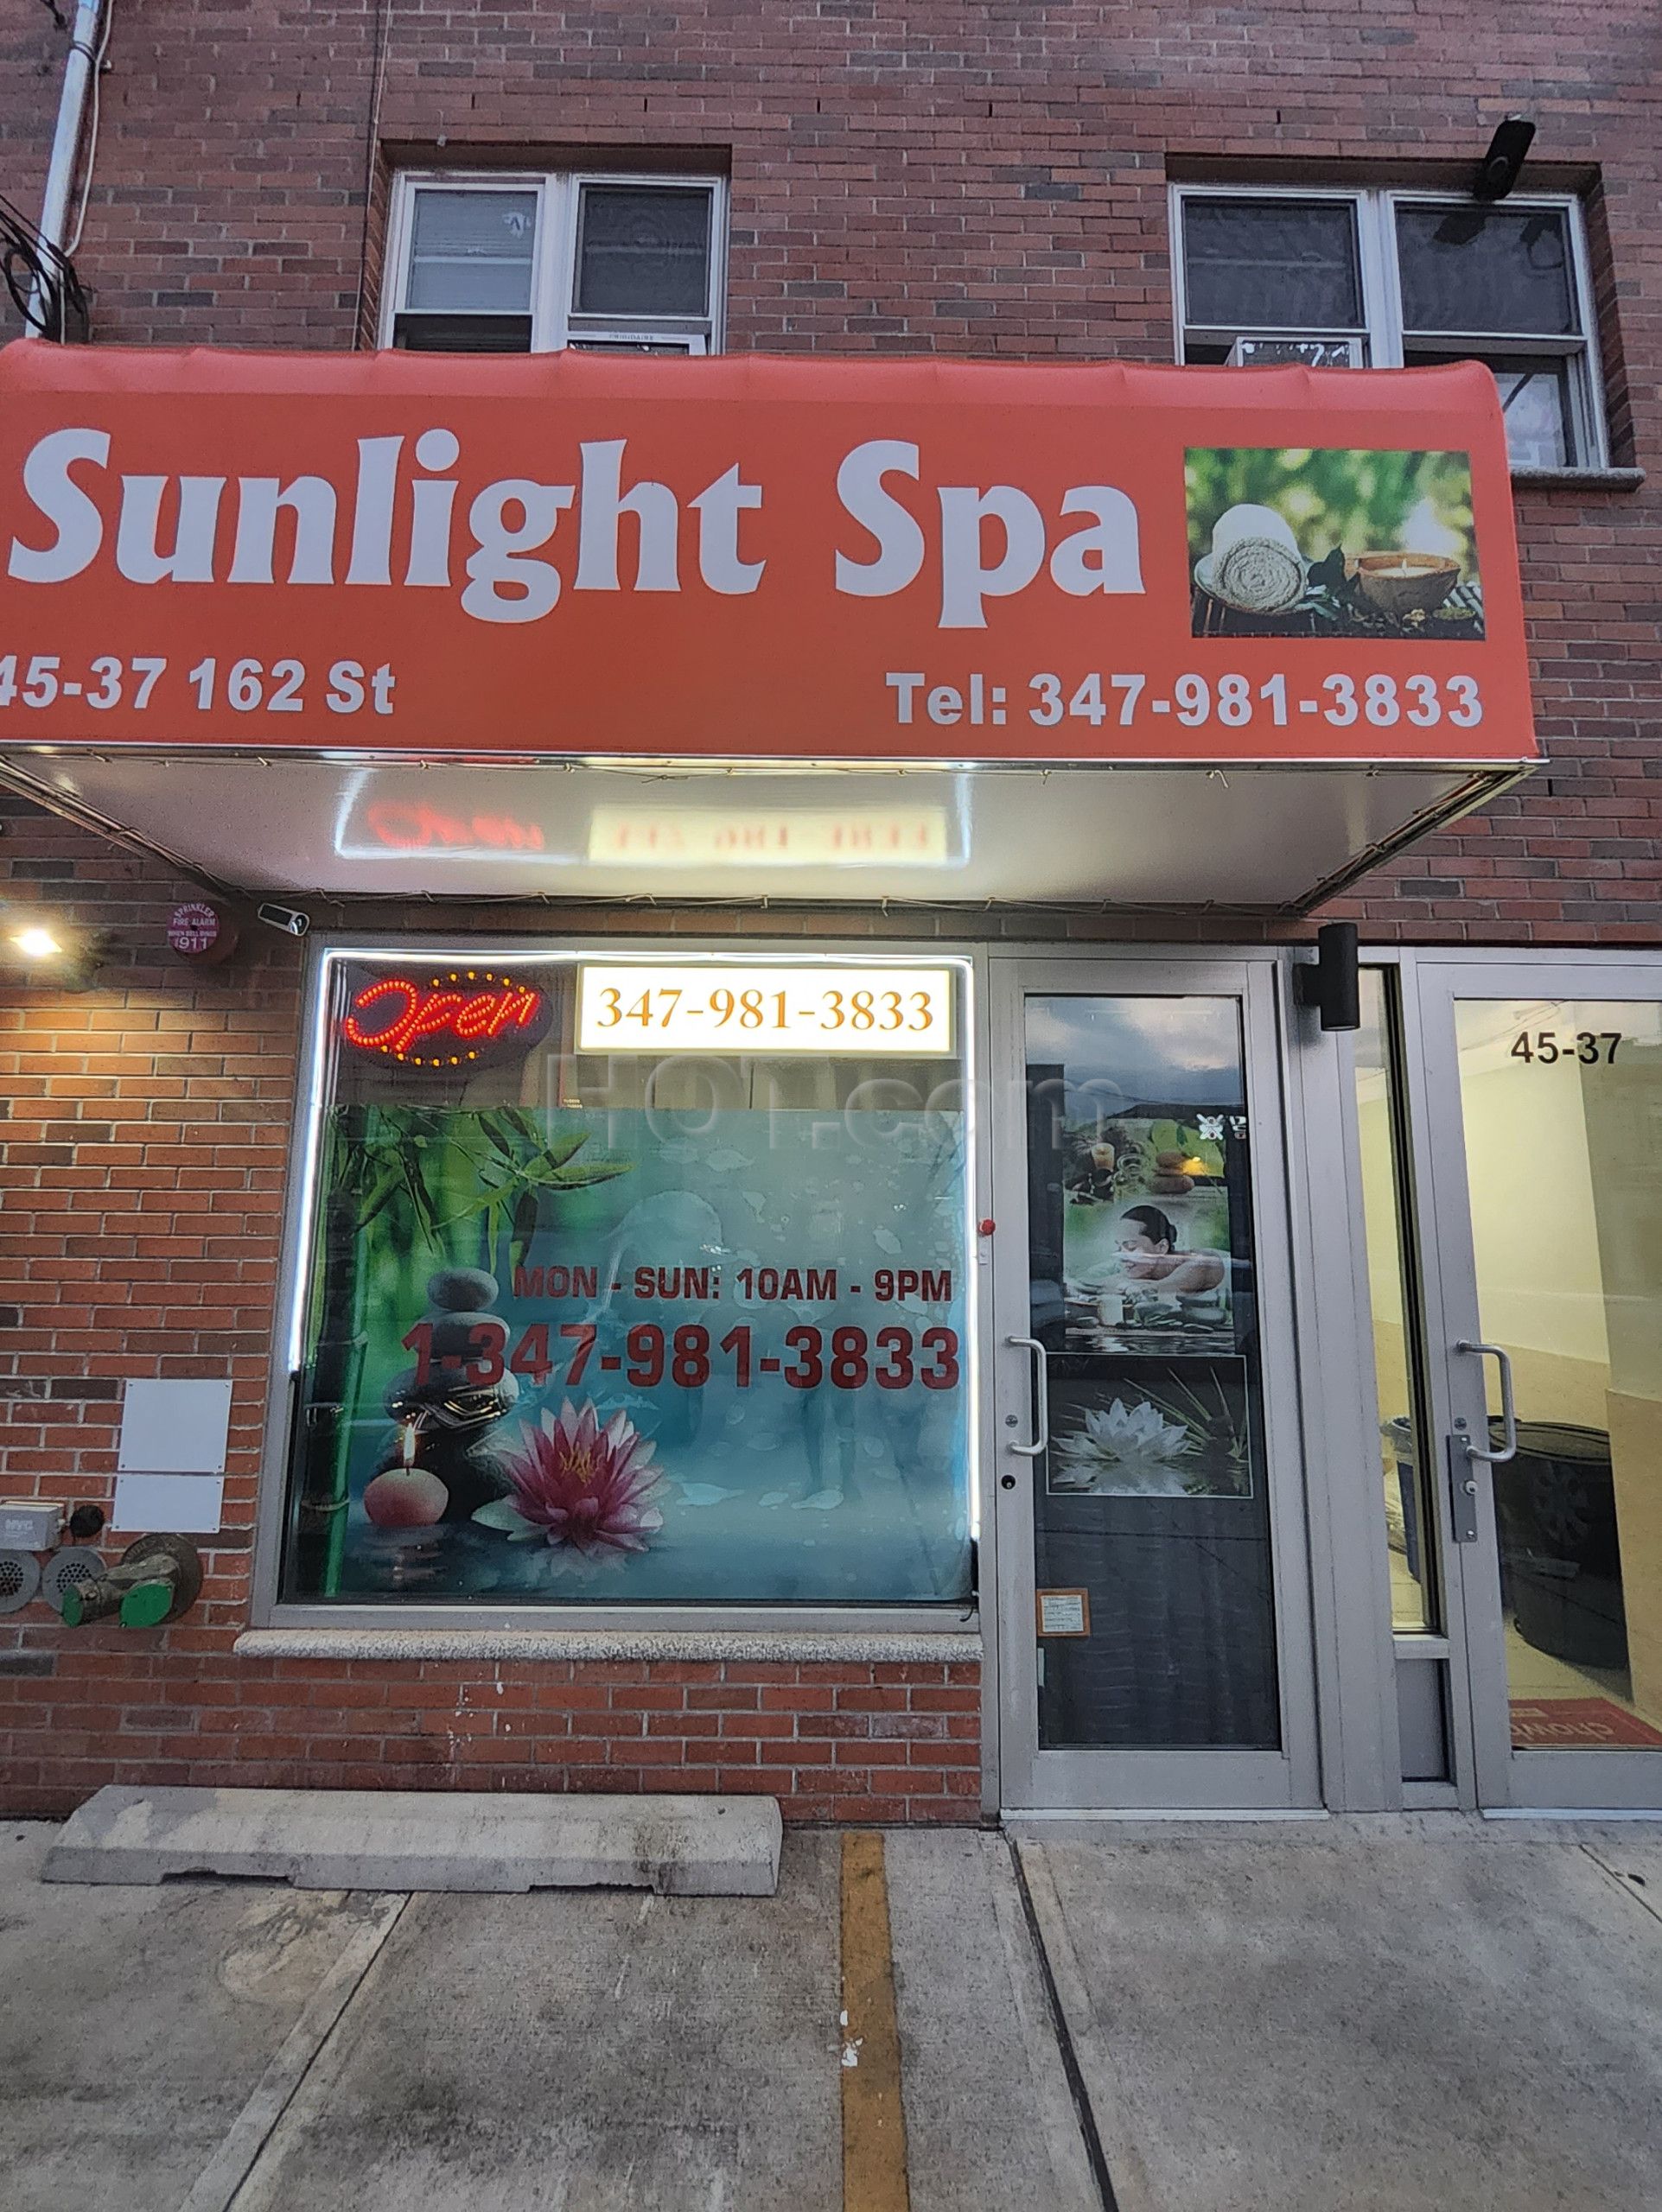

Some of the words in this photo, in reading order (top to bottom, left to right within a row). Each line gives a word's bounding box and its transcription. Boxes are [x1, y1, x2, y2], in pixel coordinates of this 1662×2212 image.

[8, 427, 767, 624] Sunlight
[835, 439, 1147, 629] Spa
[188, 658, 306, 712] 162
[325, 660, 396, 715] St
[885, 671, 1008, 726] Tel:
[1028, 672, 1484, 728] 347-981-3833
[173, 918, 189, 926] FIRE
[191, 918, 216, 926] ALARM
[174, 902, 215, 918] SPRINKLER
[178, 937, 207, 950] 911
[344, 978, 541, 1052] Open
[596, 988, 934, 1031] 347-981-3833
[1511, 1032, 1623, 1065] 45-37
[513, 1267, 598, 1299] MON
[635, 1267, 720, 1300] SUN:
[737, 1268, 837, 1301] 10AM
[875, 1268, 952, 1302] 9PM
[402, 1323, 958, 1389] 1-347-981-3833
